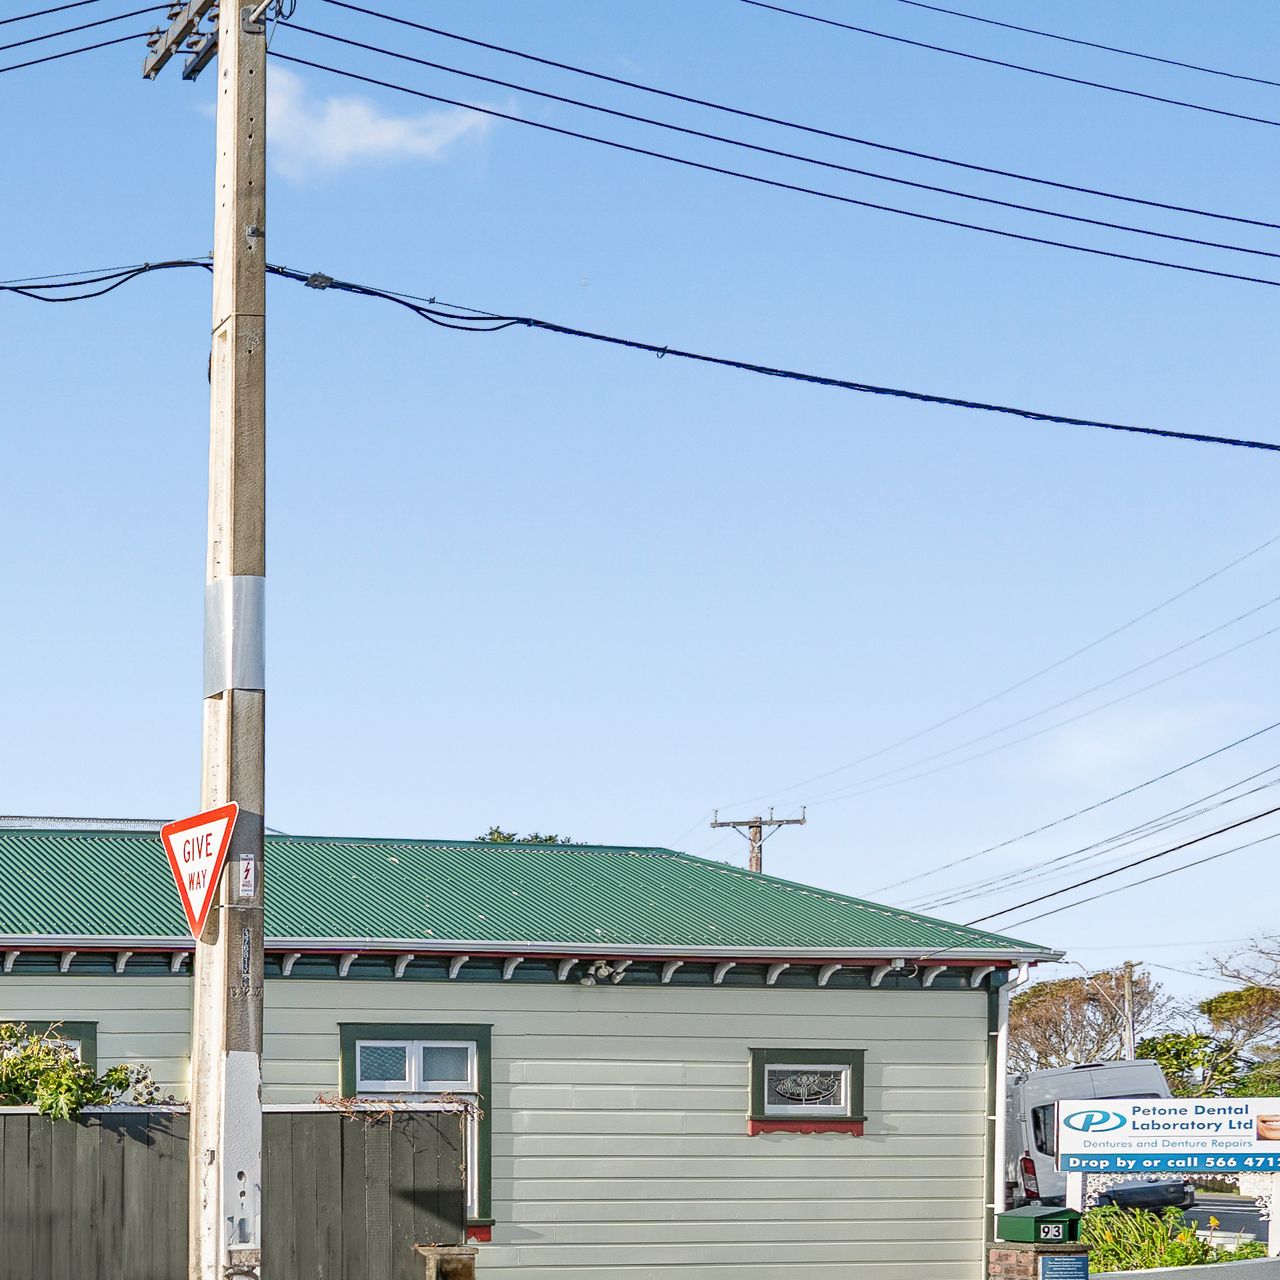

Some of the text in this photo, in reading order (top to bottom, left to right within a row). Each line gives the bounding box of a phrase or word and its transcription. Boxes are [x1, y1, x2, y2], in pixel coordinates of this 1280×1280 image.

[183, 833, 213, 863] GIVE
[188, 869, 207, 891] WAY
[1132, 1104, 1249, 1116] Petone Dental
[1132, 1119, 1253, 1132] Laboratory Ltd
[1083, 1139, 1253, 1148] Dentures and Denture Repairs
[1069, 1158, 1110, 1169] Drop
[1116, 1157, 1136, 1169] by
[1167, 1157, 1198, 1167] call
[1205, 1157, 1237, 1167] 566
[1042, 1225, 1061, 1238] 93
